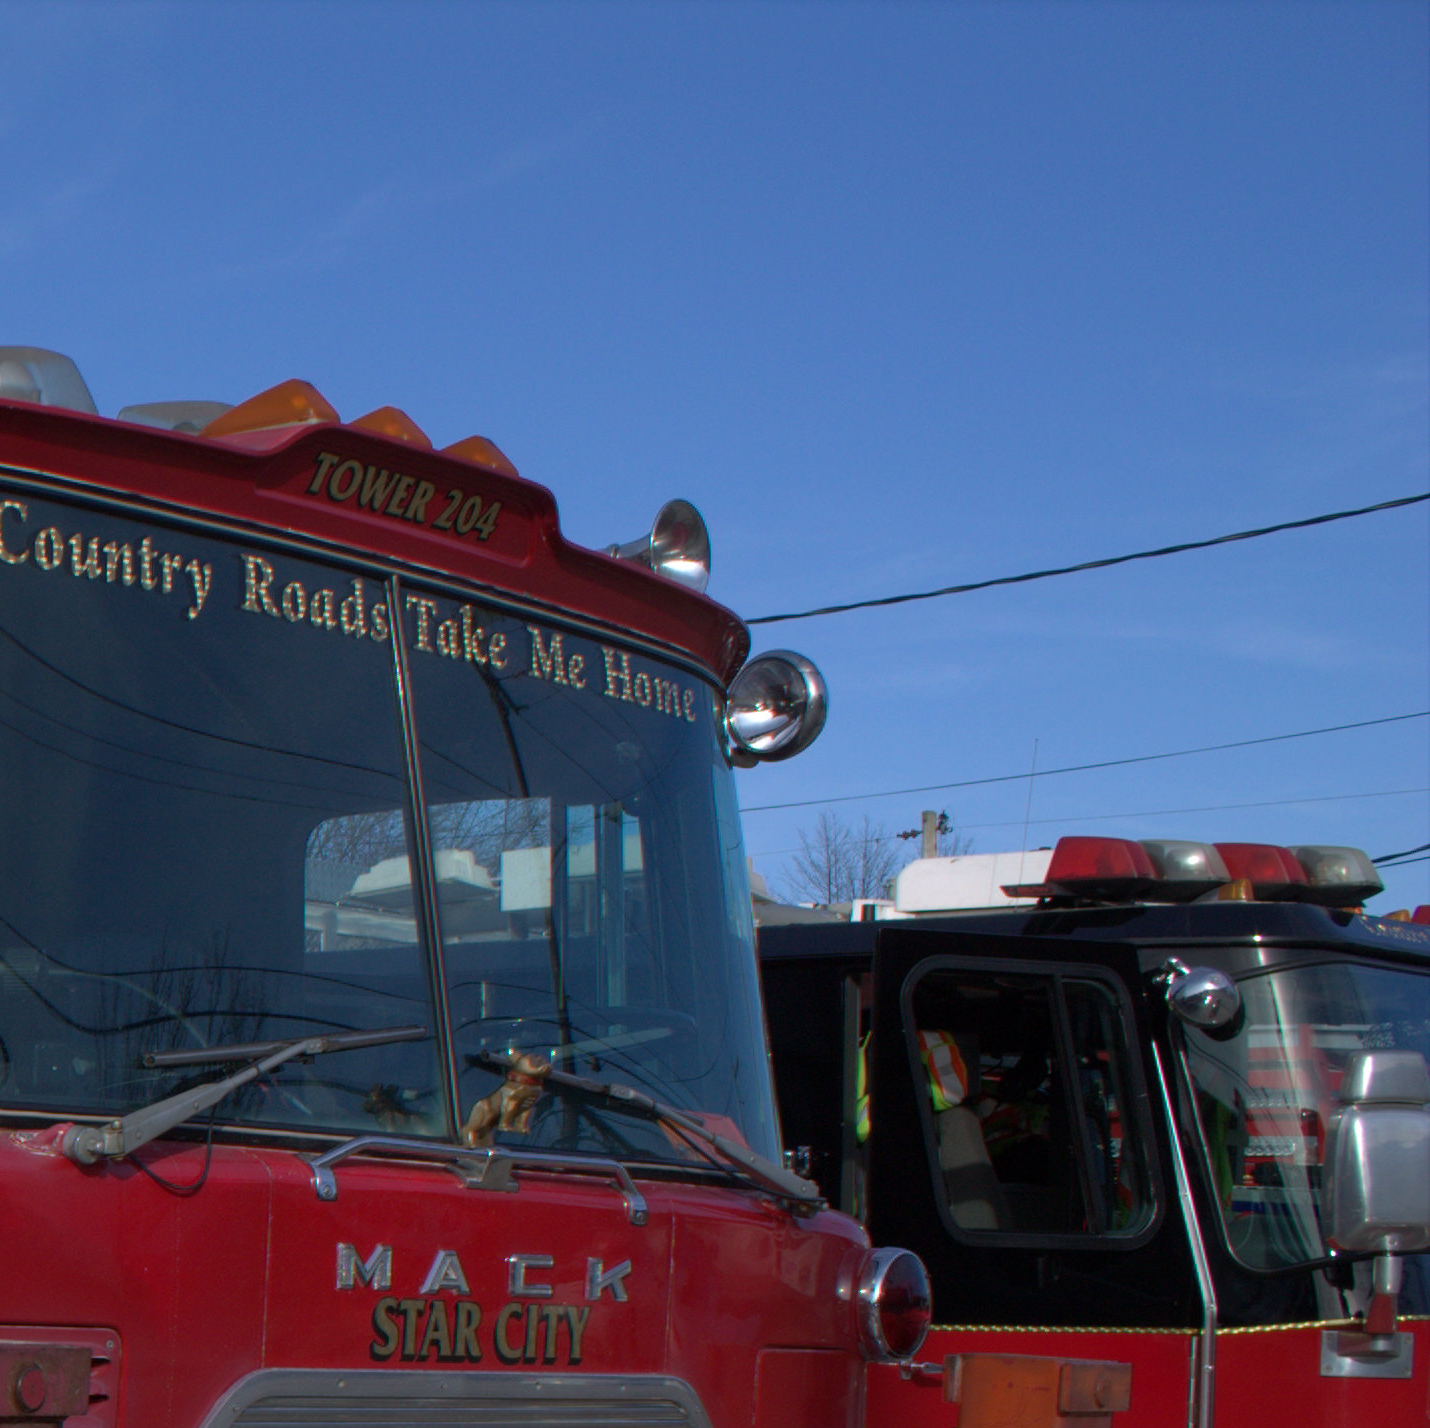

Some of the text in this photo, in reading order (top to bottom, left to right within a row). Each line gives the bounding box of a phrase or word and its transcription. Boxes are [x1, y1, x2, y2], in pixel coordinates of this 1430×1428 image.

[306, 451, 502, 541] TOWER 204
[240, 553, 388, 643] Roads
[405, 593, 508, 670] Take
[526, 624, 586, 690] Me
[601, 645, 696, 723] Home
[335, 1242, 633, 1302] MACK
[369, 1297, 591, 1366] STAR CITY
